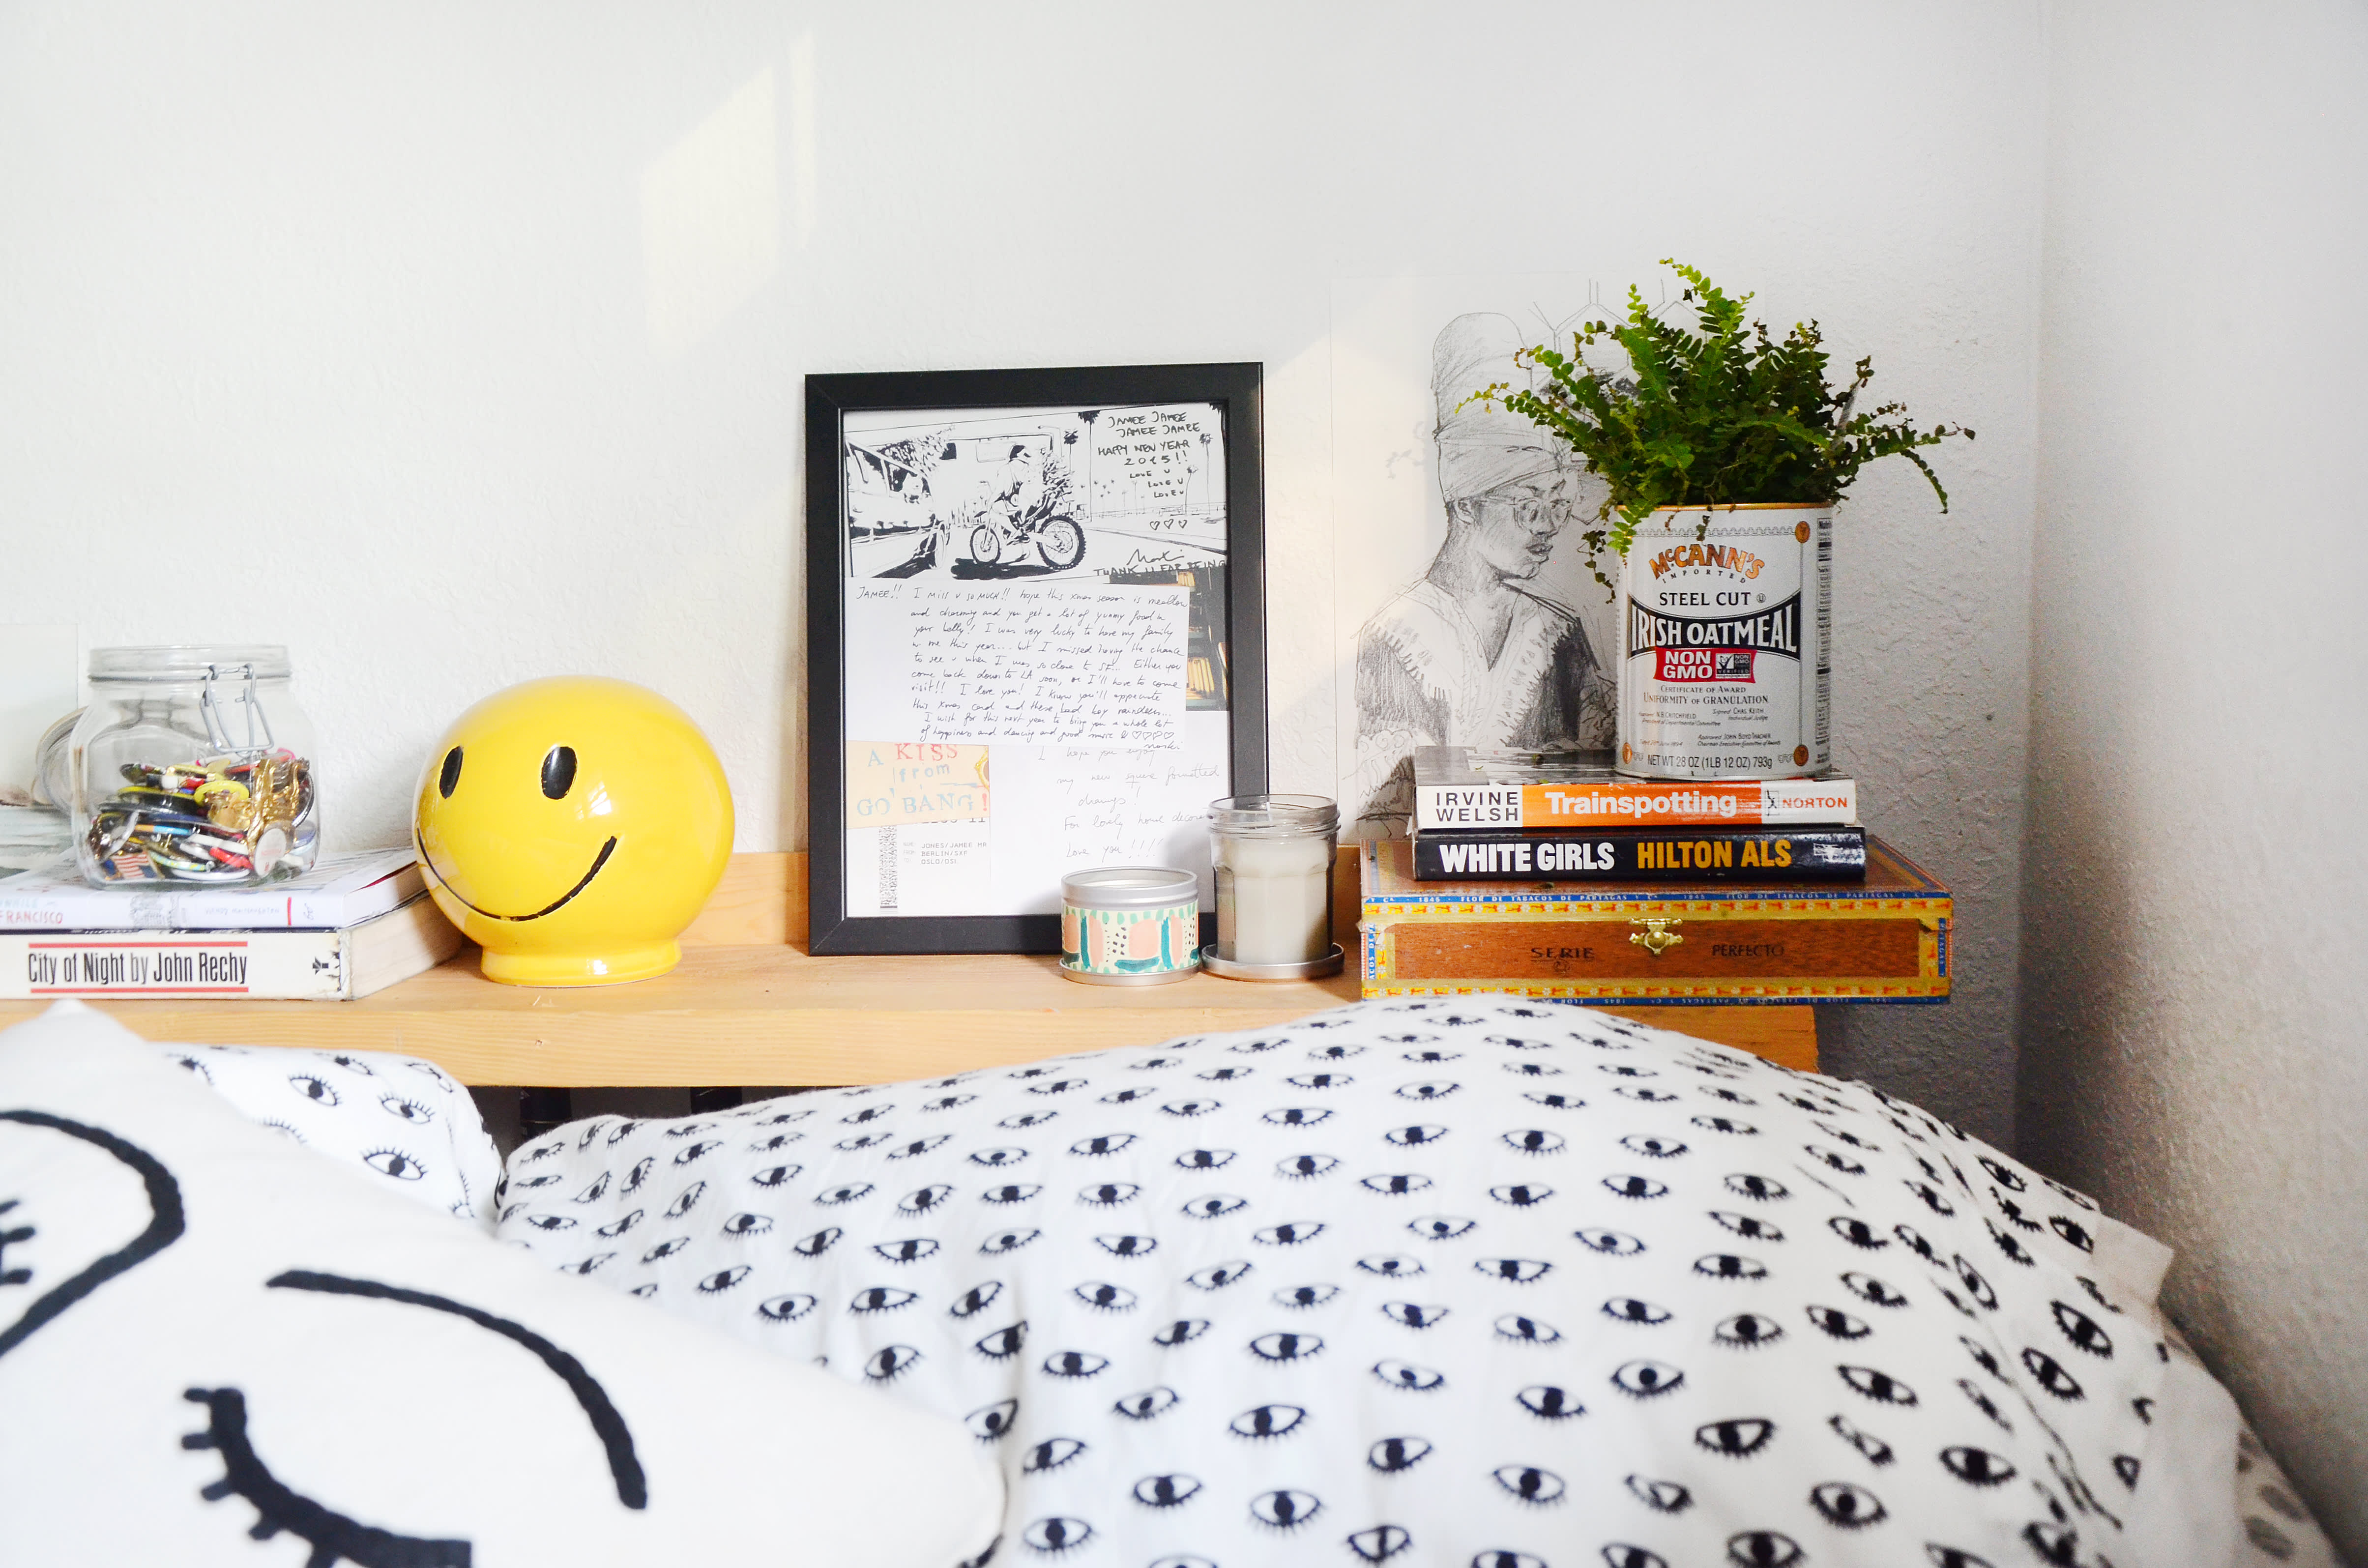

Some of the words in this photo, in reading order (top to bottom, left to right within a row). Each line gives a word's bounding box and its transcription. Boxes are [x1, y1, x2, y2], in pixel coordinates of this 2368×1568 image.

[1108, 415, 1146, 429] JAMEE
[1151, 410, 1187, 423] JAMEE
[1115, 426, 1158, 438] JAMEE
[1162, 422, 1200, 435] JAMEE
[1098, 444, 1128, 457] HAPPY
[1134, 443, 1156, 453] NEW
[1159, 439, 1191, 451] YEAR
[1129, 470, 1152, 479] LOVE
[1147, 480, 1171, 488] LOVE
[1153, 489, 1177, 498] LOVE
[1663, 569, 1745, 583] IMPORTED
[856, 583, 903, 600] JAMEE!!
[913, 587, 923, 599] I
[1020, 589, 1040, 605] hope
[1046, 587, 1064, 601] this
[1660, 592, 1710, 606] STEEL
[1716, 592, 1751, 605] CUT
[910, 607, 930, 617] and
[939, 607, 977, 627] charming
[982, 608, 1001, 616] and
[1024, 606, 1043, 624] get
[1058, 607, 1076, 618] lot
[1077, 609, 1090, 627] of
[1094, 611, 1125, 624] yummy
[1128, 610, 1156, 627] food
[913, 626, 934, 638] your
[984, 622, 995, 633] I
[1024, 628, 1043, 643] very
[1050, 623, 1076, 640] lucky
[1098, 625, 1117, 637] have
[1140, 622, 1173, 644] family
[1632, 604, 1682, 651] IRISH
[1687, 604, 1798, 652] OATMEAL
[949, 637, 968, 649] this
[1017, 639, 1032, 651] but
[1038, 641, 1052, 652] I
[1056, 645, 1093, 655] missed
[1098, 644, 1123, 664] having
[1131, 642, 1143, 653] the
[1150, 643, 1185, 656] chance
[1666, 651, 1711, 665] NON
[965, 655, 987, 663] when
[1050, 660, 1074, 670] close
[1133, 656, 1161, 670] Either
[943, 668, 966, 678] back
[976, 669, 1000, 680] down
[1020, 669, 1033, 680] LA
[1112, 677, 1132, 687] have
[1152, 680, 1181, 689] come
[1663, 665, 1712, 678] GMO
[959, 683, 972, 696] I
[975, 685, 995, 696] love
[1643, 692, 1688, 704] UNIFORMITY
[1703, 696, 1768, 704] GRANULATION
[912, 697, 929, 710] this
[971, 701, 995, 711] card
[937, 712, 956, 723] wish
[963, 712, 977, 727] for
[983, 711, 999, 722] this
[1004, 712, 1025, 723] next
[1123, 719, 1147, 728] whole
[1154, 718, 1174, 728] lot
[920, 724, 931, 743] of
[933, 726, 972, 741] happiness
[977, 726, 997, 736] and
[1039, 726, 1058, 736] and
[868, 749, 884, 767] A
[894, 743, 958, 761] KISS
[1066, 747, 1090, 761] hope
[1098, 750, 1117, 762] you
[1648, 755, 1661, 765] NET
[1663, 755, 1676, 766] WT
[1676, 756, 1686, 766] 28
[1688, 757, 1699, 767] OZ
[1702, 757, 1721, 770] (1LB
[1724, 757, 1734, 767] 12
[1736, 756, 1751, 769] OZ)
[1753, 755, 1773, 769] 793g
[899, 763, 950, 783] from
[857, 798, 891, 816] GO
[1437, 792, 1518, 806] IRVINE
[1545, 791, 1737, 818] Trainspotting
[1782, 797, 1847, 809] NORTON
[1436, 808, 1518, 822] WELSH
[1064, 815, 1080, 831] For
[1092, 813, 1123, 841] lovely
[1066, 842, 1090, 858] Love
[1102, 845, 1122, 863] you
[1439, 843, 1531, 873] WHITE
[1537, 842, 1615, 871] GIRLS
[1637, 841, 1732, 869] HILTON
[1741, 839, 1792, 868] ALS
[1531, 947, 1595, 959] SERIE
[1712, 945, 1784, 957] PERFECTO
[28, 953, 58, 987] City
[63, 953, 77, 982] of
[84, 952, 126, 985] Night
[130, 952, 148, 985] by
[153, 952, 193, 982] John
[199, 952, 247, 985] Rechy
